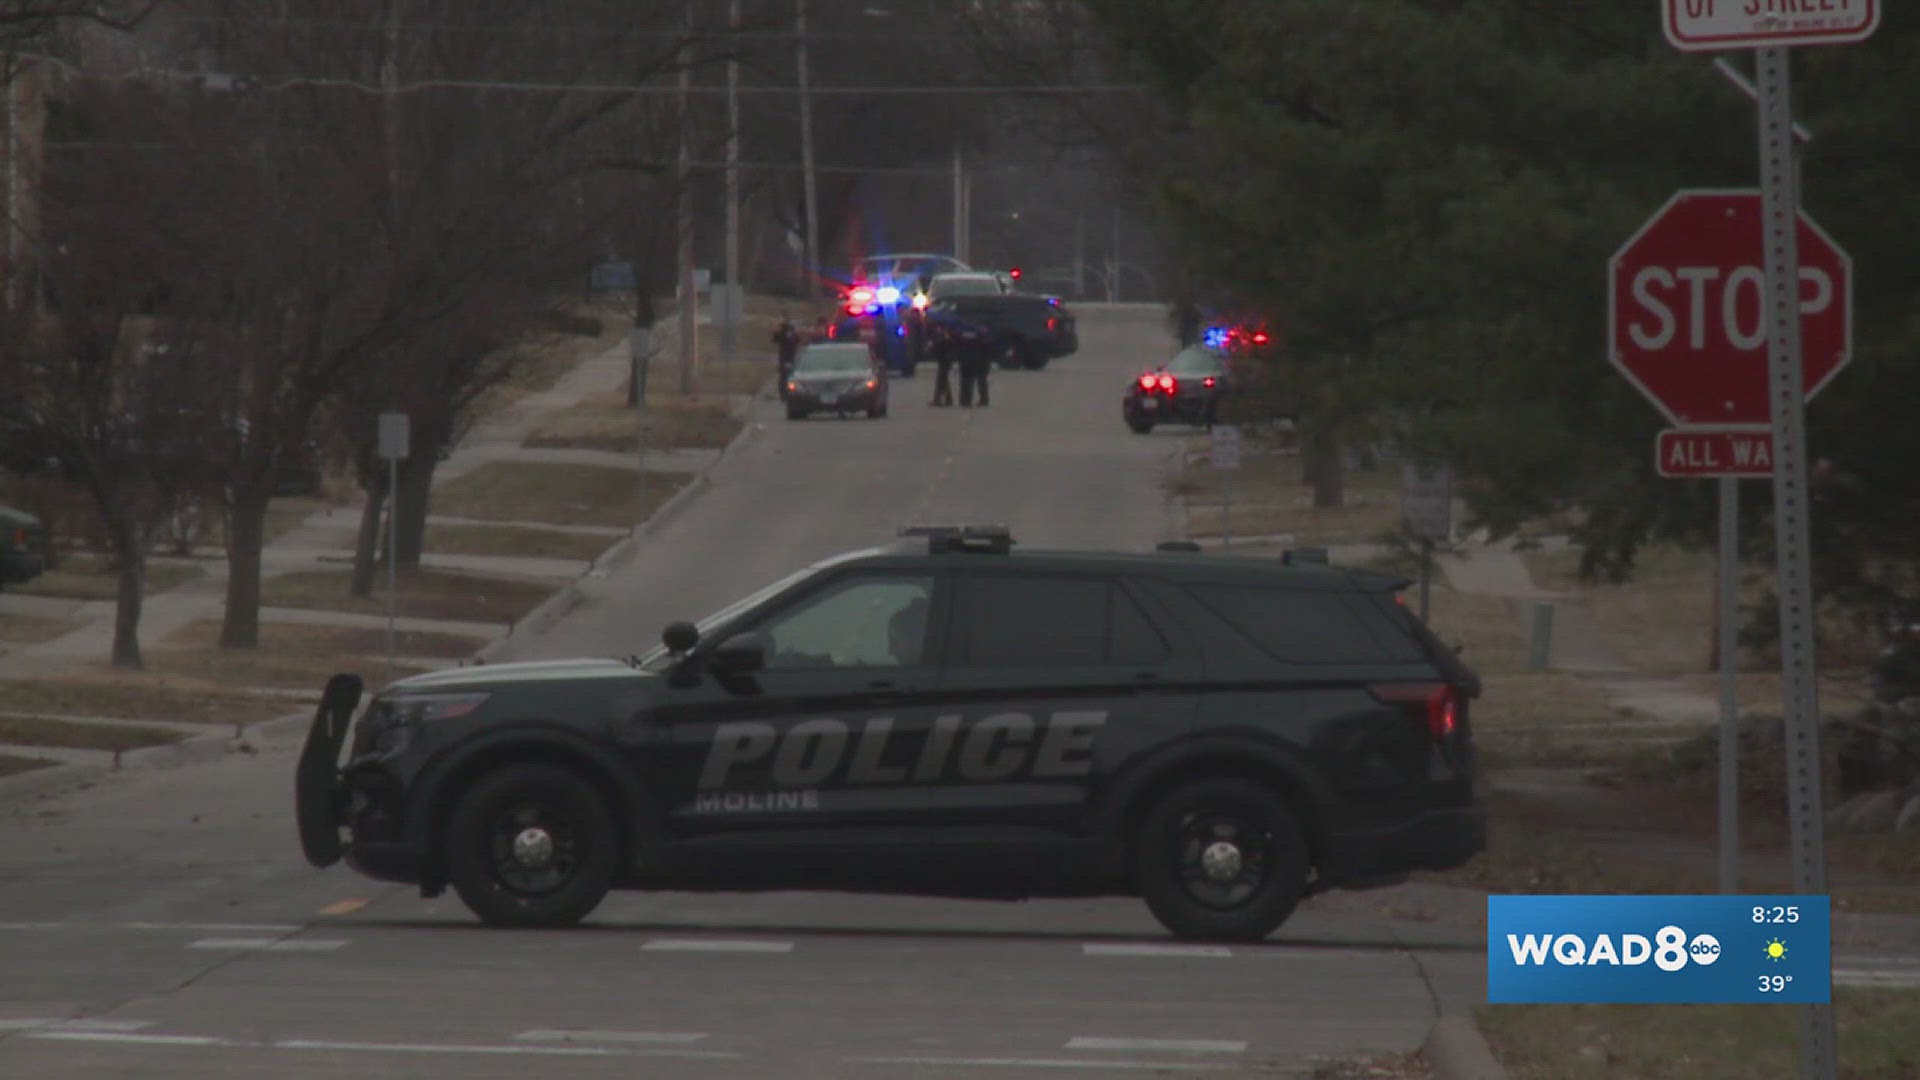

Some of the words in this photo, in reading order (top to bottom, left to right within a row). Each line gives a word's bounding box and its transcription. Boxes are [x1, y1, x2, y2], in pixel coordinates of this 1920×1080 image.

[1628, 266, 1832, 350] STOP
[1670, 440, 1718, 466] ALL
[1731, 440, 1771, 466] WA
[697, 710, 1110, 789] POLICE
[696, 789, 819, 812] MOLINE
